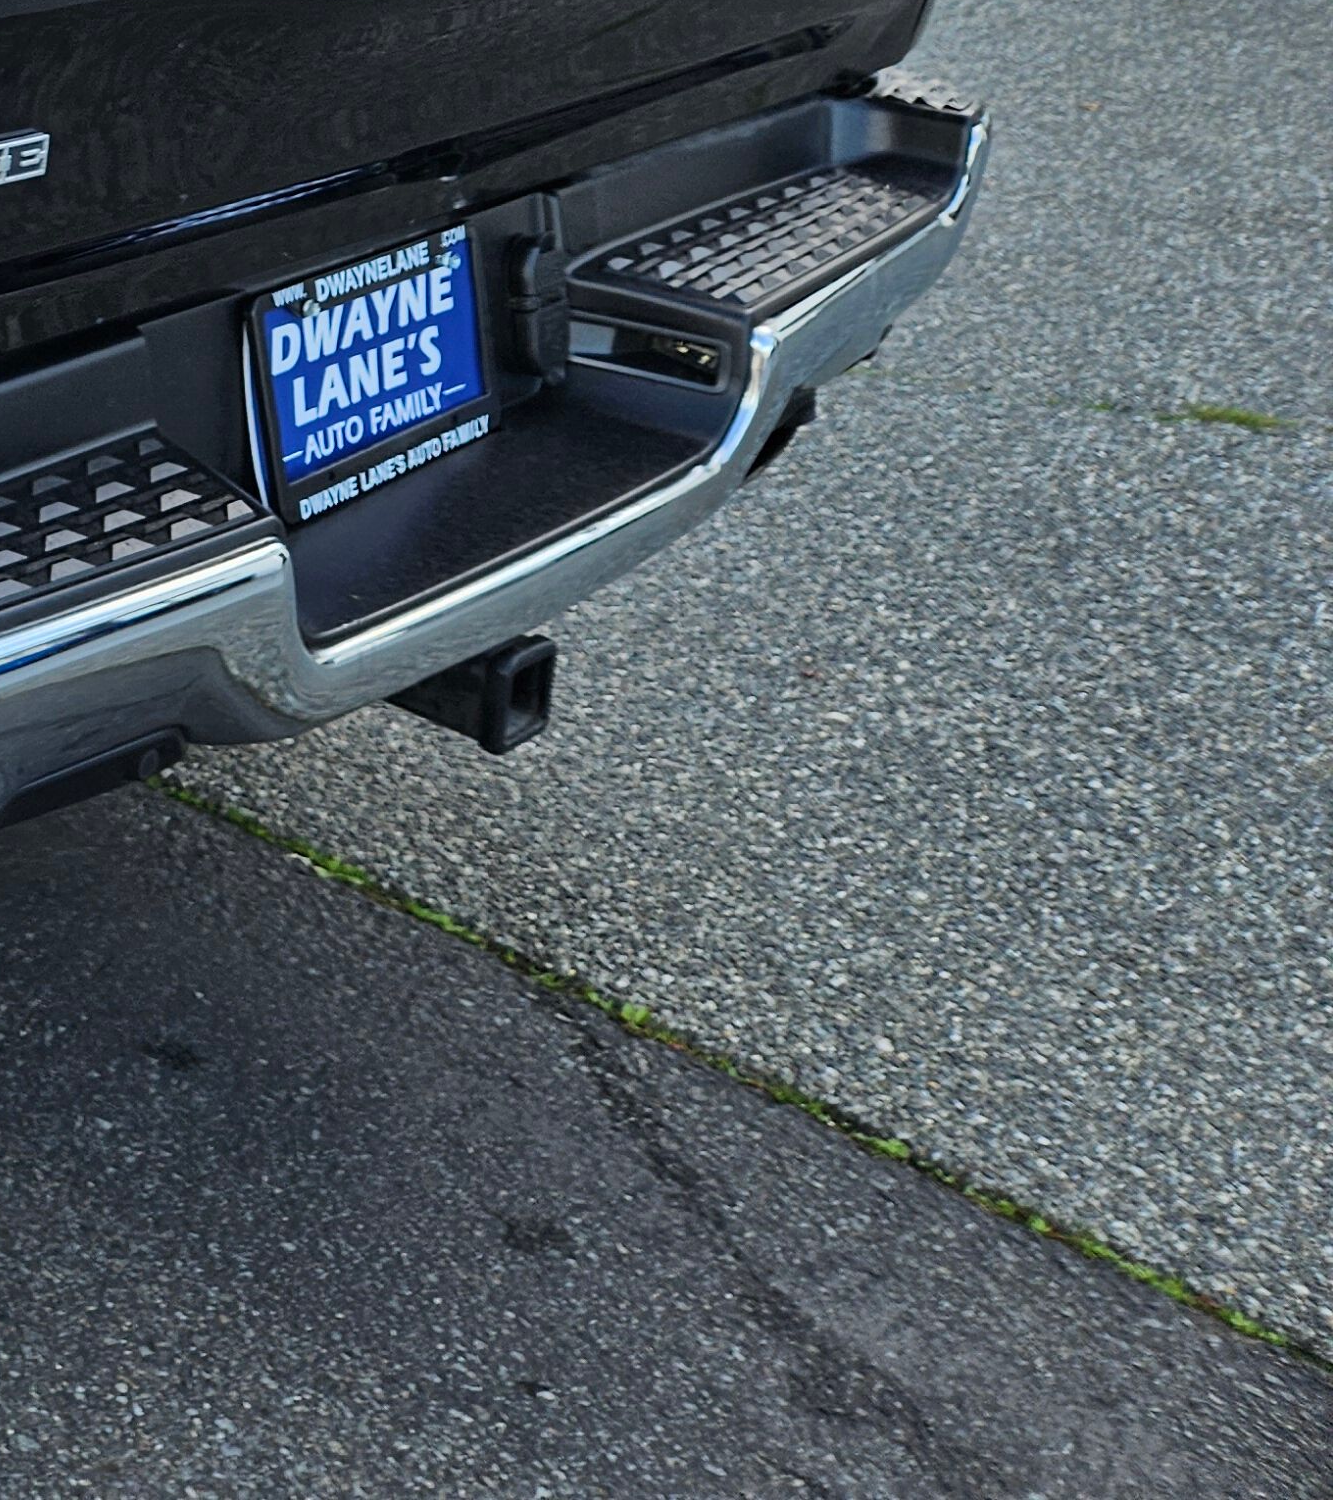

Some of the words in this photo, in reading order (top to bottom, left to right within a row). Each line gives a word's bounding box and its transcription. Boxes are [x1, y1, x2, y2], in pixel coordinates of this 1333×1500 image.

[271, 265, 454, 377] DWAYNE
[314, 240, 430, 303] DWAYNELANE
[293, 325, 442, 428] LANE'S
[299, 474, 360, 521] DWAYNE
[406, 436, 442, 470] AUTO
[440, 413, 490, 453] FAMILY
